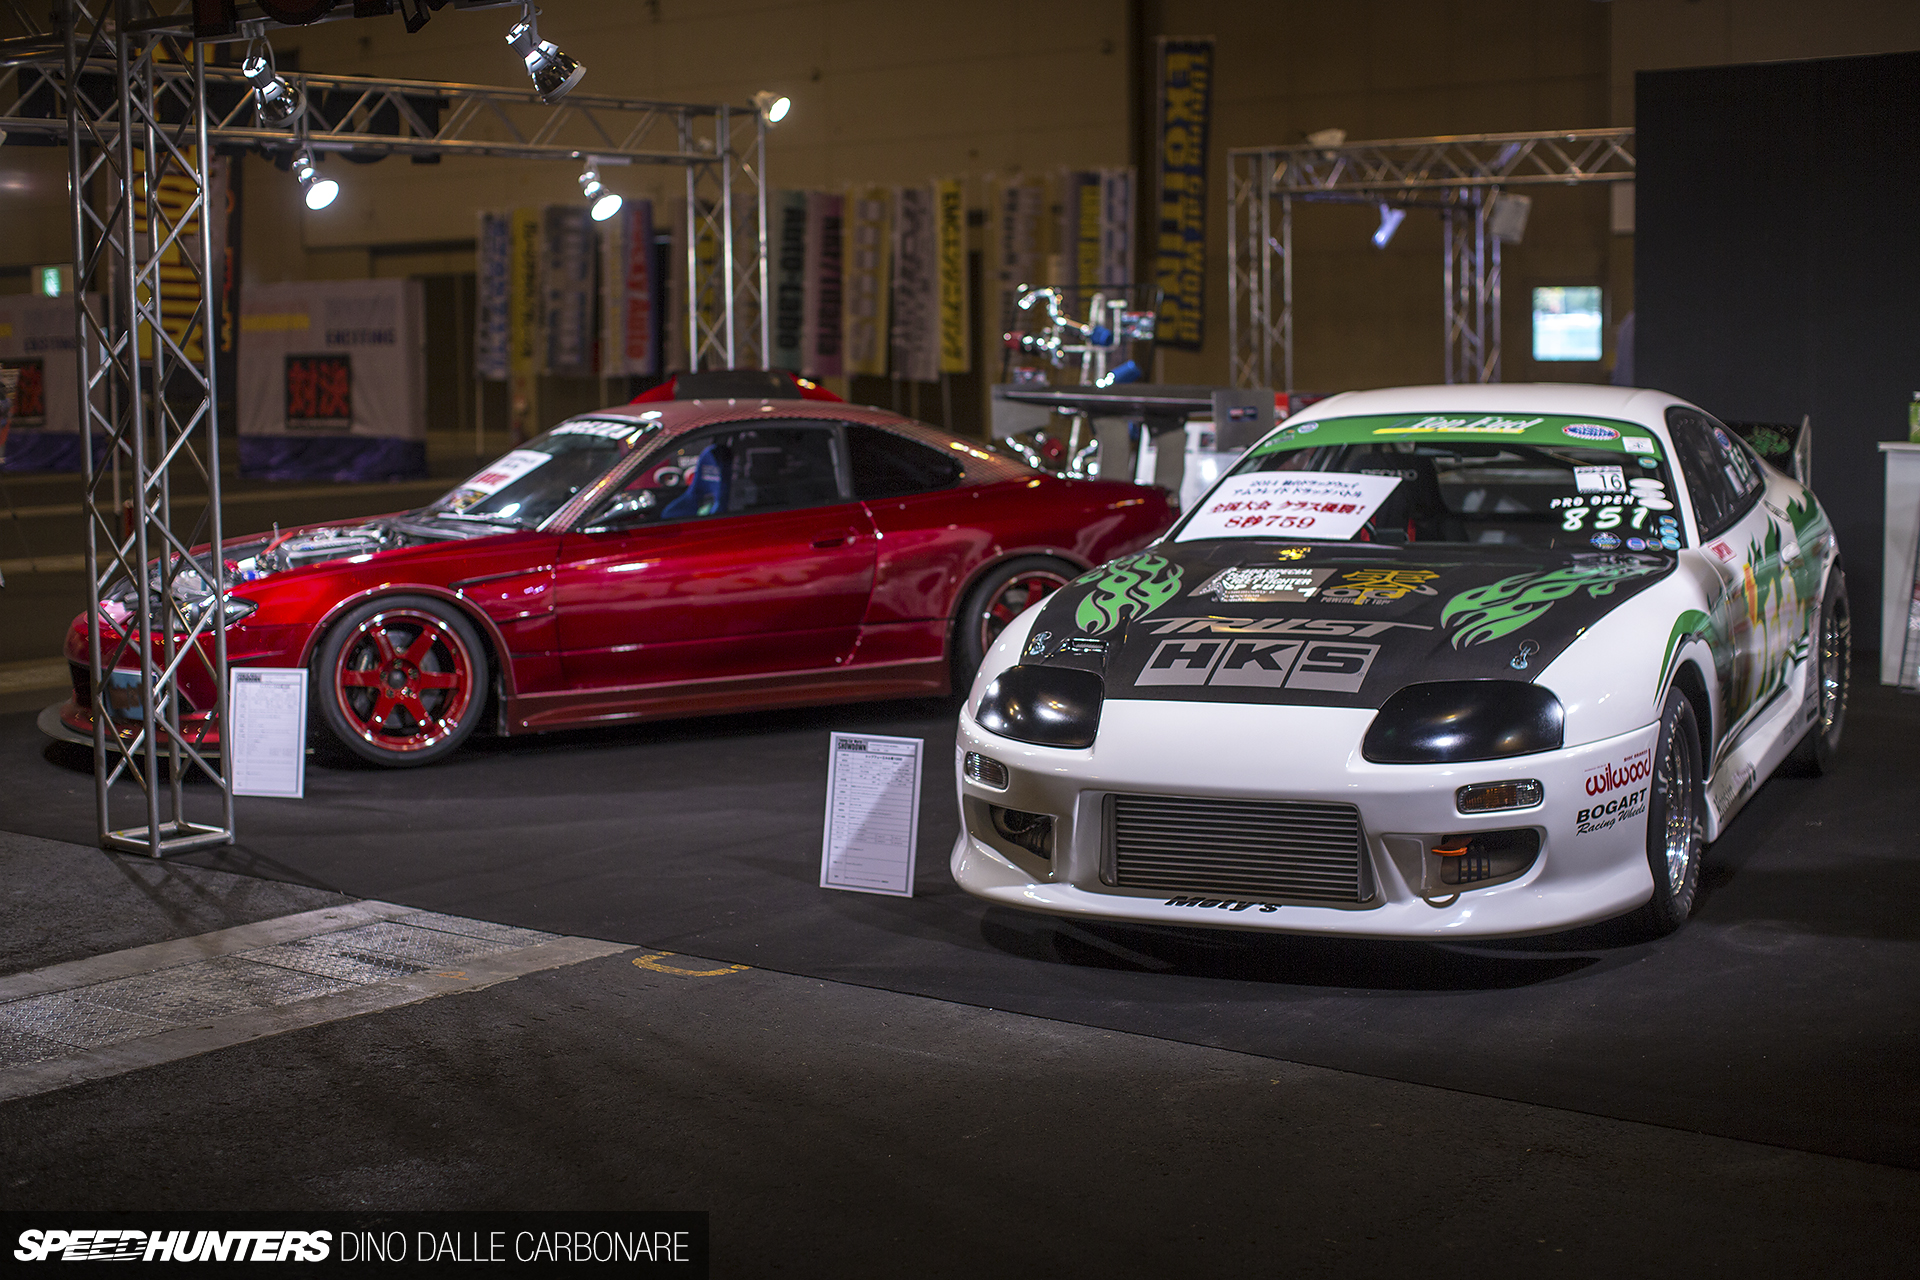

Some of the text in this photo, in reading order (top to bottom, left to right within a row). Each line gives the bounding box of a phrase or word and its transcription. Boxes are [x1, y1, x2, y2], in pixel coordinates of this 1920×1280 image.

[1599, 473, 1623, 491] 16
[1550, 494, 1636, 509] PRO OPEN
[1561, 506, 1650, 532] 851
[1139, 615, 1435, 637] TRUST
[1147, 642, 1373, 680] HKS
[1585, 748, 1651, 797] wilwood
[1576, 787, 1648, 825] BOGART
[1576, 804, 1647, 837] Racing Wheels
